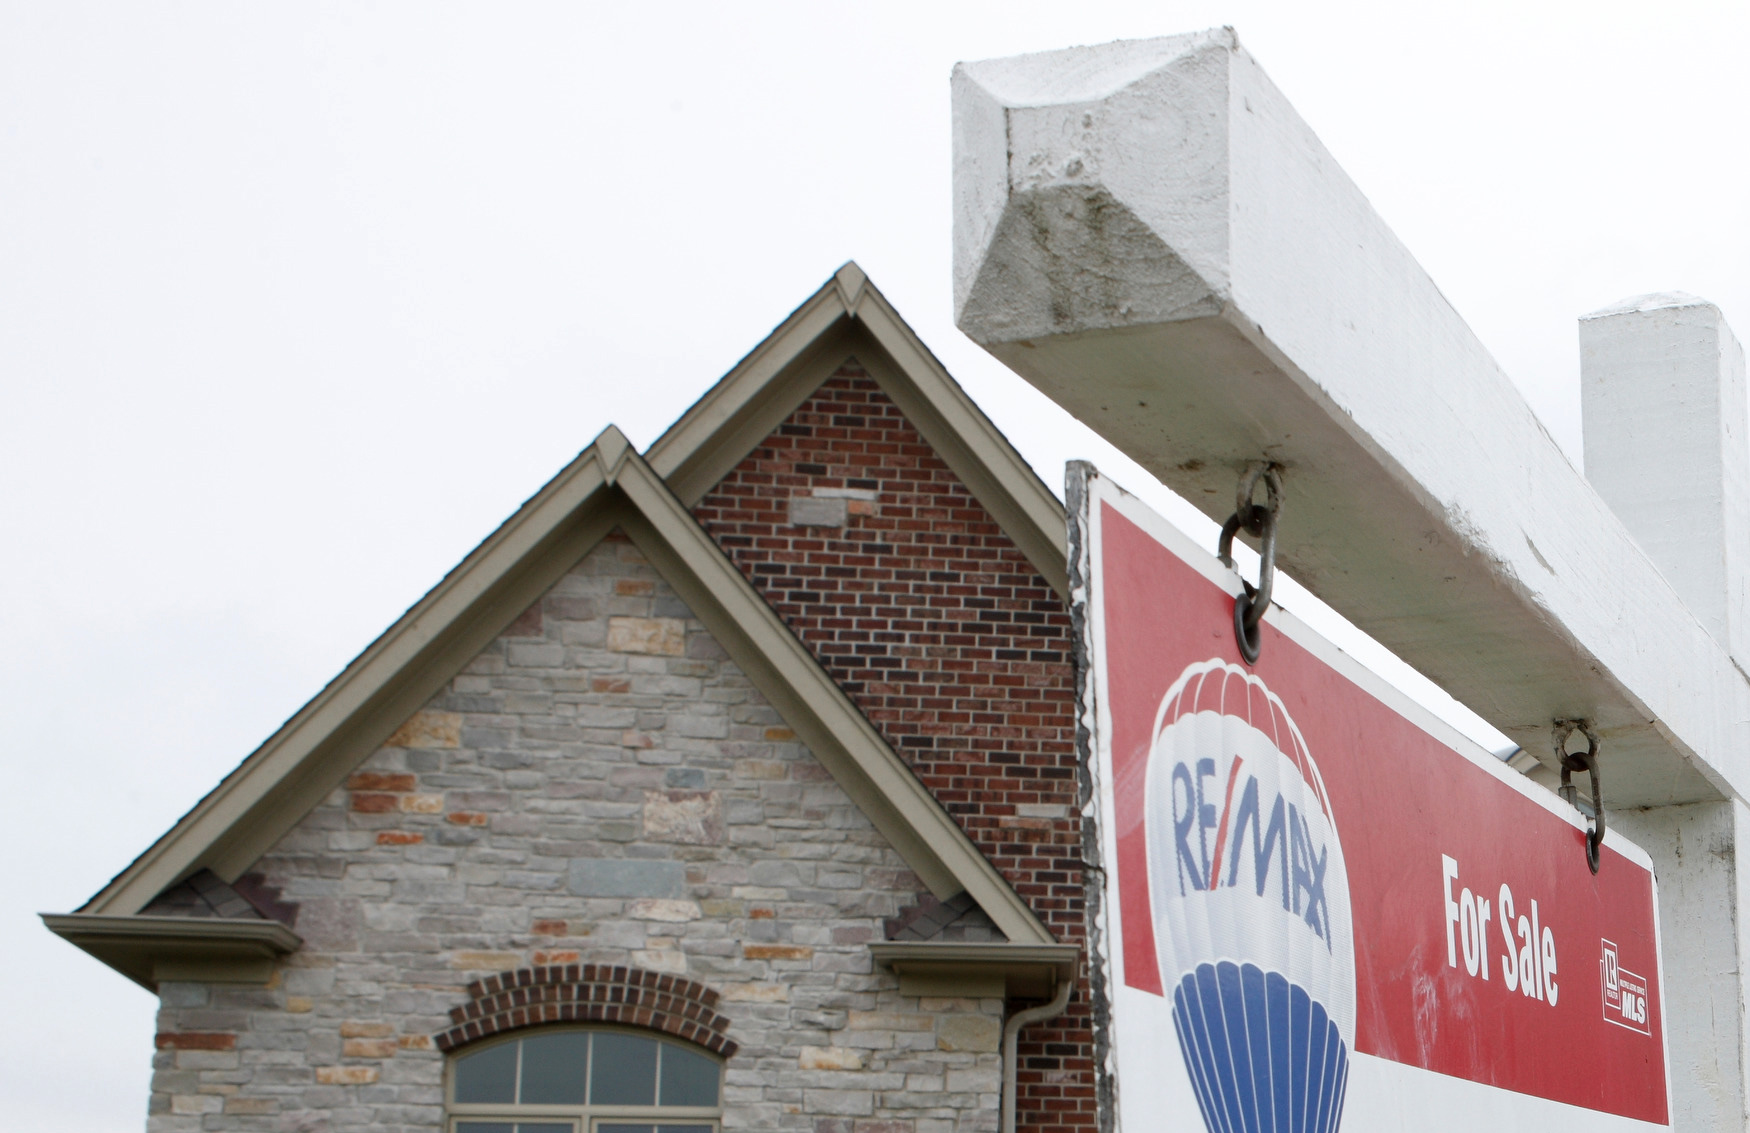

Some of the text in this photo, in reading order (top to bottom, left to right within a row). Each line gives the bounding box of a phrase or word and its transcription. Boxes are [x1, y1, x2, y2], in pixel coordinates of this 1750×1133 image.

[1172, 754, 1333, 957] RE/MAX
[1442, 853, 1558, 1007] For Sale
[1622, 991, 1646, 1024] MLS
